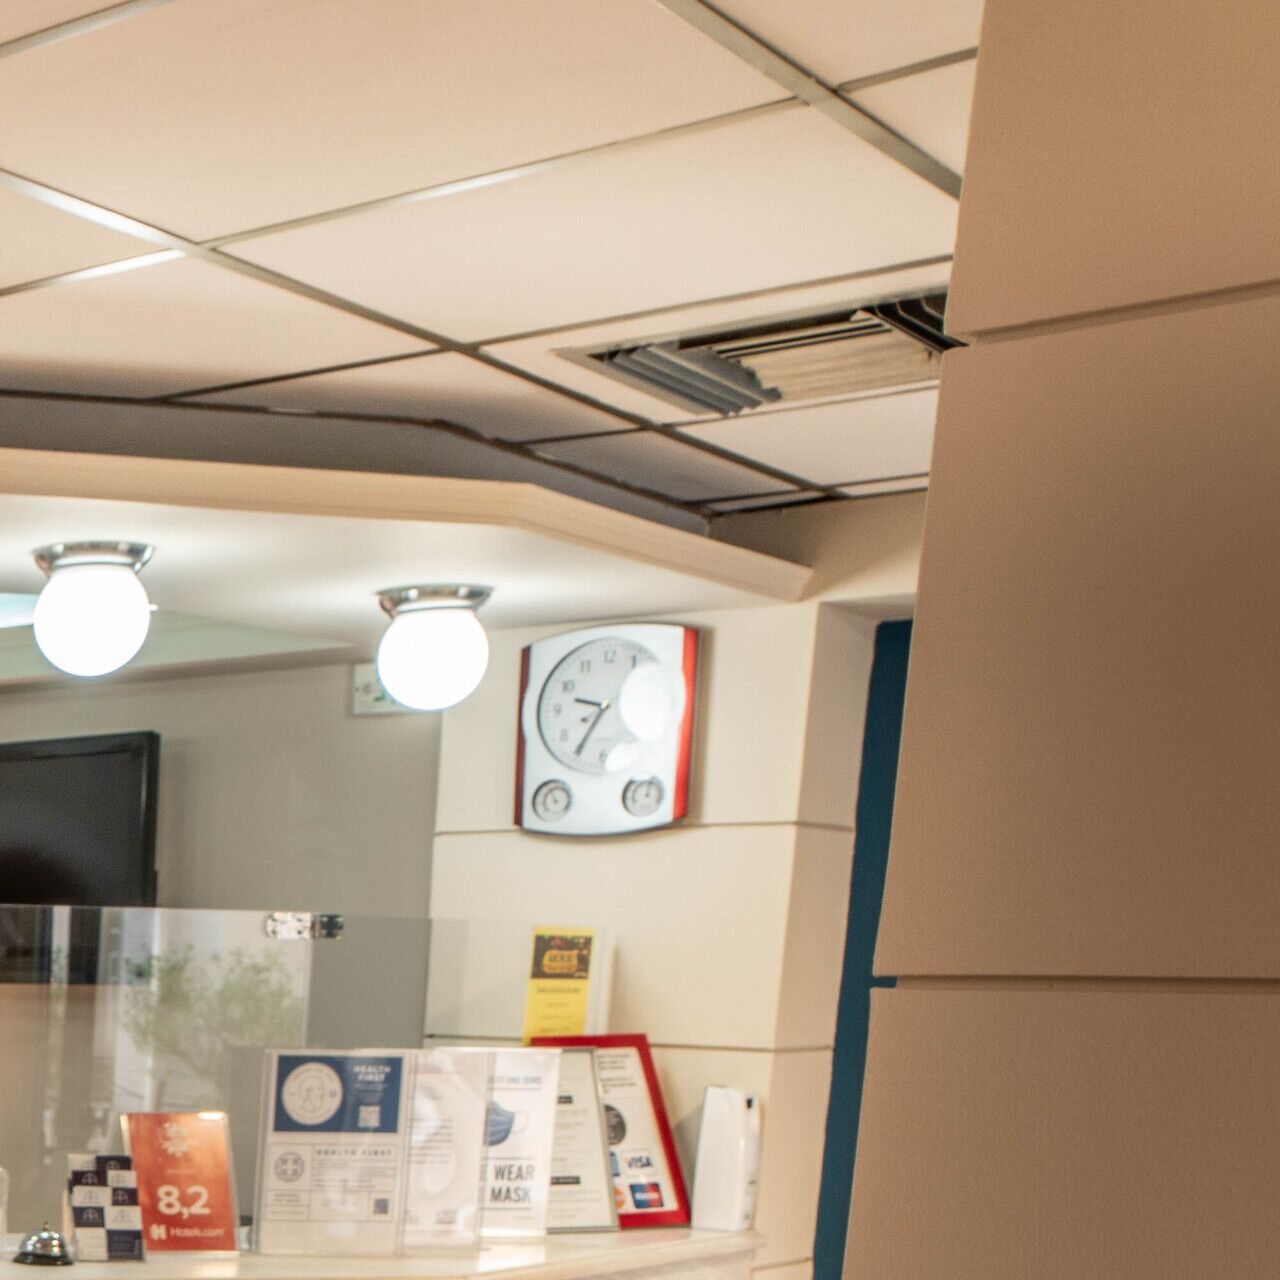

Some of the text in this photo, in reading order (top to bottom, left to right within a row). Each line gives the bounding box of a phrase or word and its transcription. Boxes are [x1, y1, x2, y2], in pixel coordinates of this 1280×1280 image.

[603, 648, 617, 663] 12
[580, 658, 592, 673] 11
[353, 1065, 392, 1074] HEALTH
[358, 1073, 386, 1082] FIRST
[316, 1149, 393, 1157] HEALTH FIRST
[628, 1155, 654, 1169] VISA
[494, 1163, 536, 1182] WEAR
[157, 1184, 211, 1219] 8,2
[490, 1185, 533, 1204] MASK
[169, 1226, 225, 1238] Hotels.com
